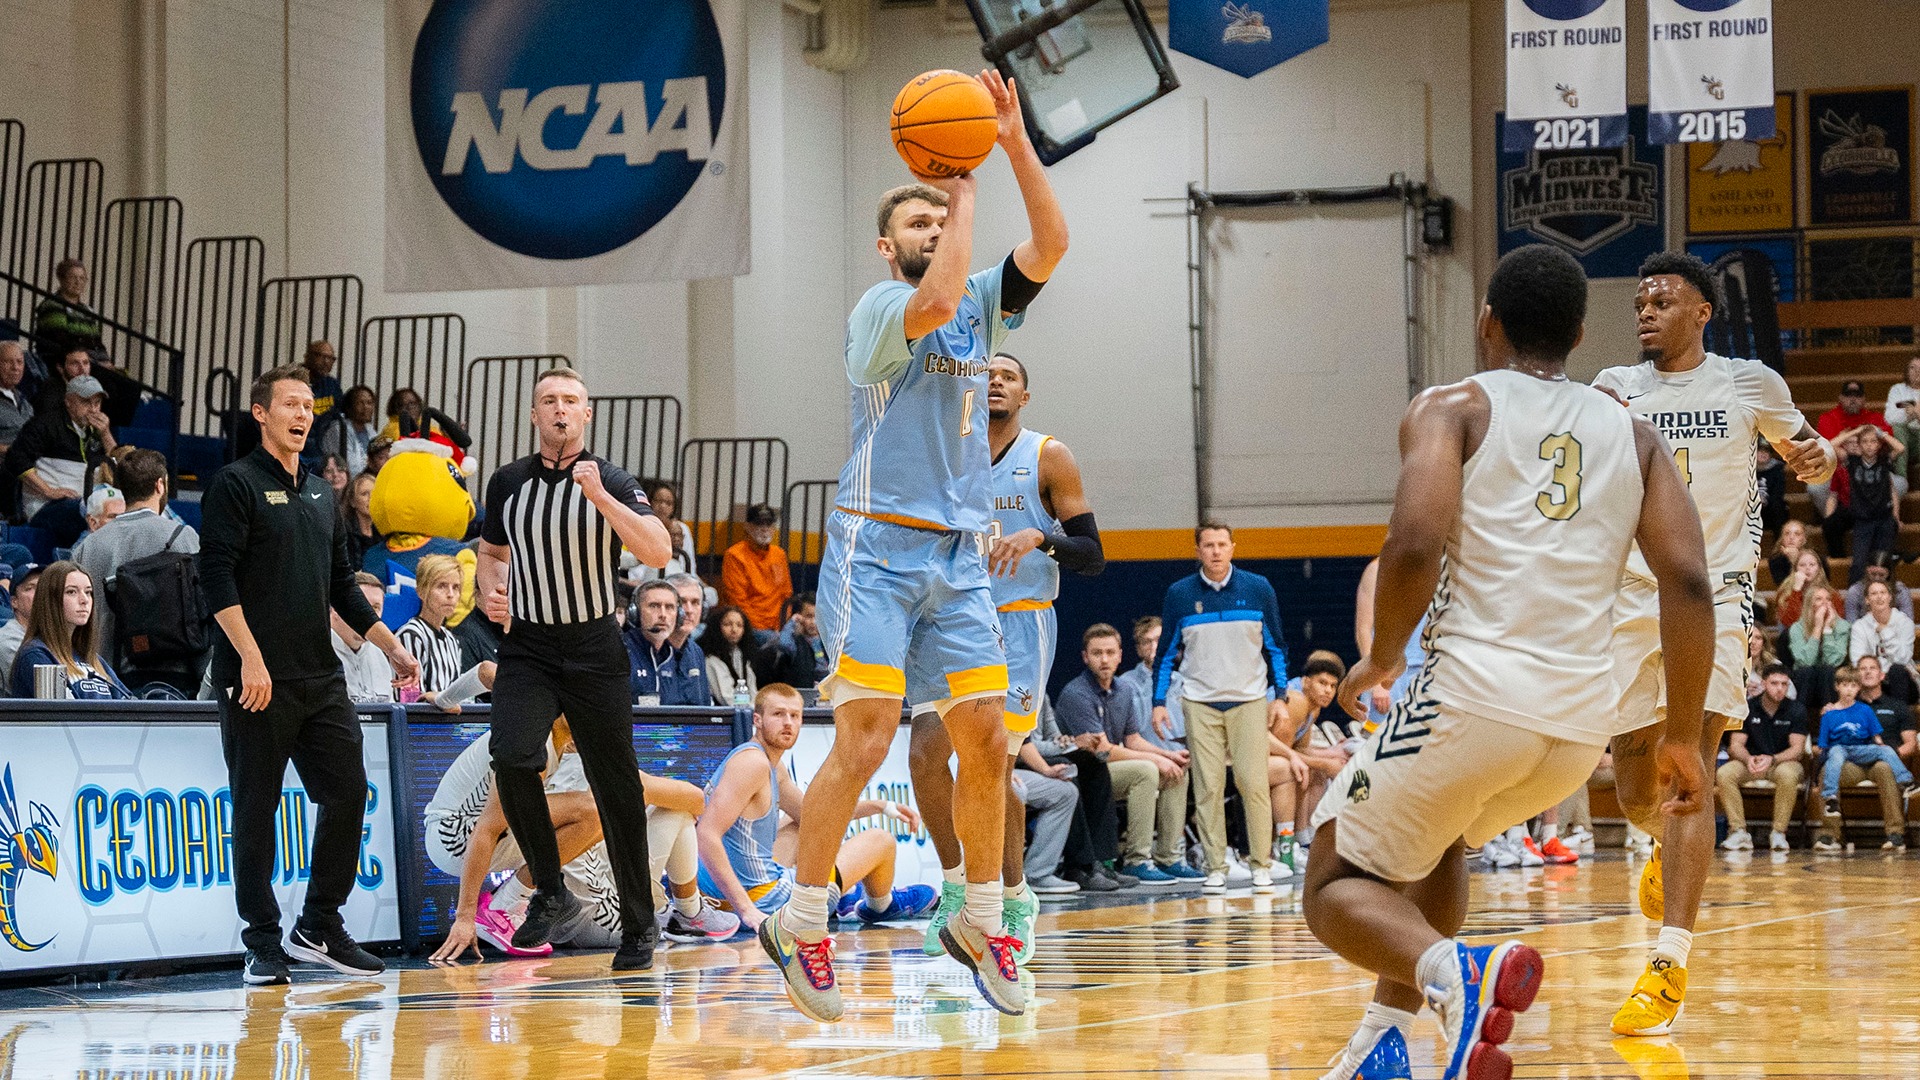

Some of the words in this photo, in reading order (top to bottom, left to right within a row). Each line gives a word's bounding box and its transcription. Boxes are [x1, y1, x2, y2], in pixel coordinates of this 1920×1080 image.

[1511, 29, 1558, 48] FIRST
[1564, 26, 1622, 46] ROUND
[1653, 21, 1703, 41] FIRST
[1708, 17, 1768, 38] ROUND
[441, 75, 713, 177] NCAA
[1533, 117, 1600, 149] 2021
[1678, 109, 1747, 143] 2015
[1546, 159, 1616, 179] GREAT
[1511, 167, 1653, 210] MIDWEST
[960, 389, 976, 437] 1
[1534, 430, 1583, 521] 3
